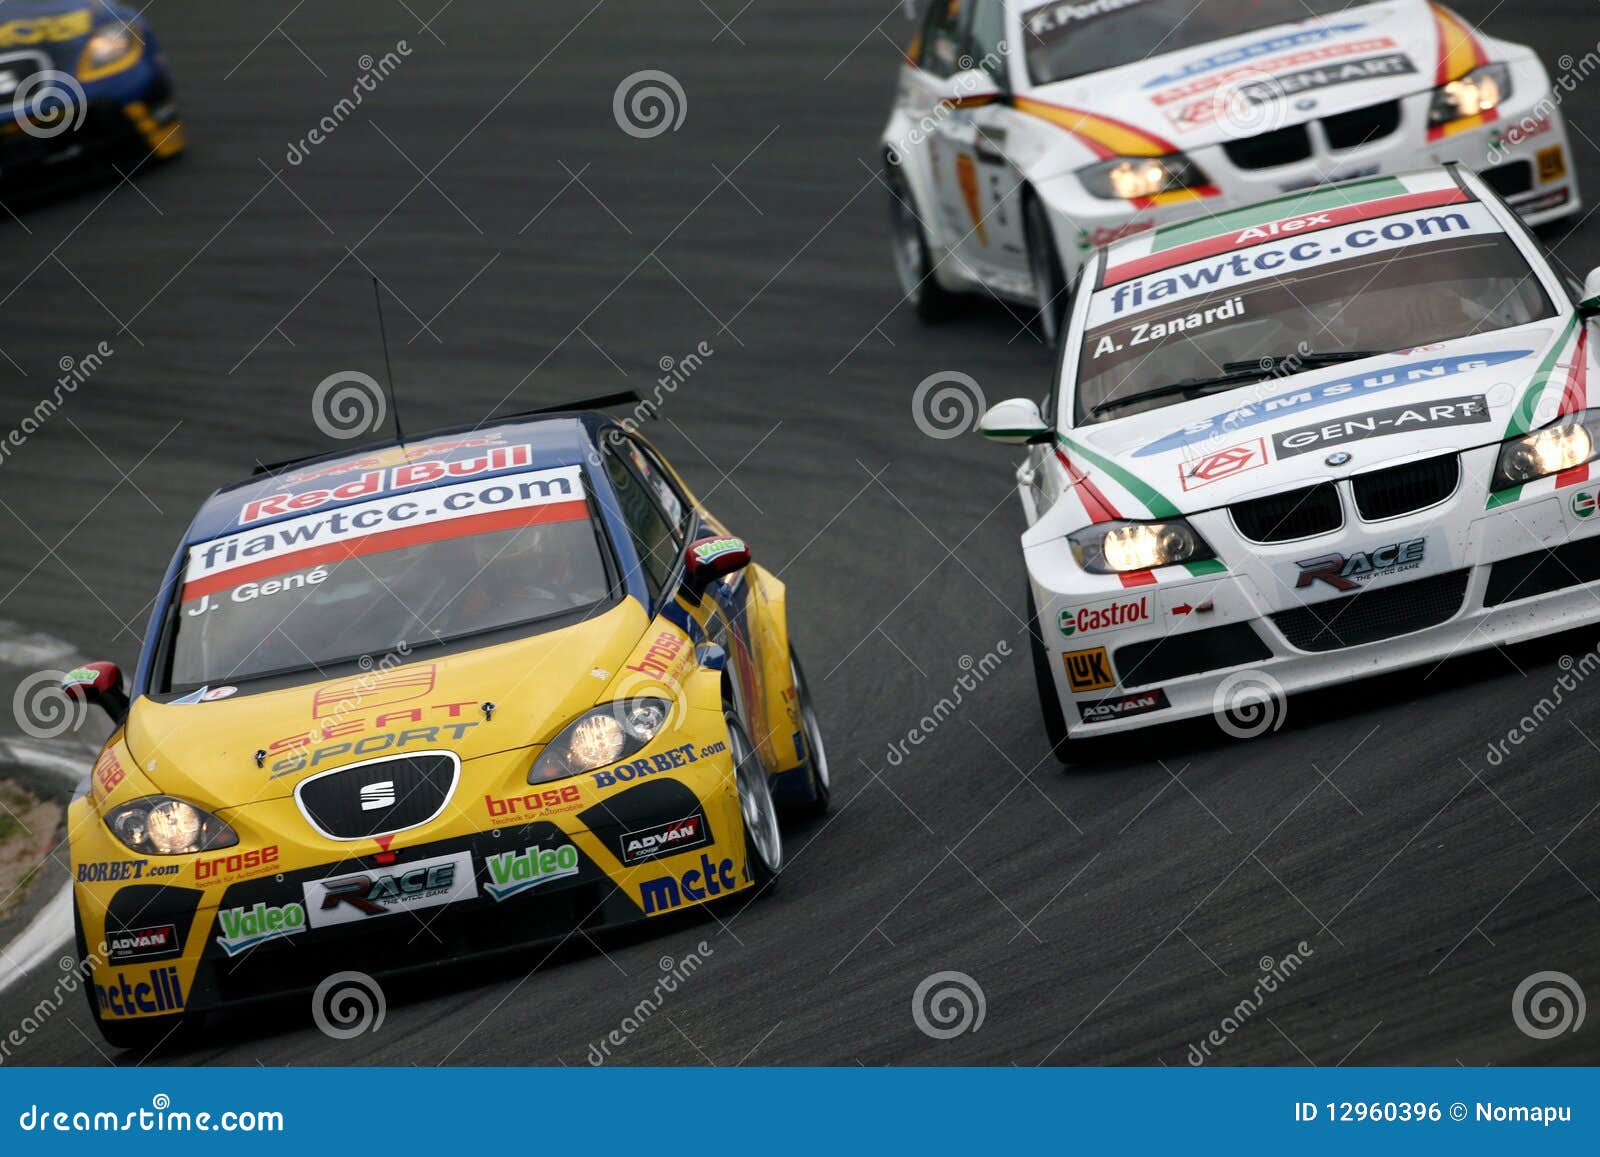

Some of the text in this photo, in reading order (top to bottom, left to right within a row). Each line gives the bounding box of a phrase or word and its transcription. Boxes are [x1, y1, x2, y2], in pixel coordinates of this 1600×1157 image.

[1235, 213, 1332, 244] Alex
[1111, 212, 1470, 314] fiawtcc.com
[1092, 297, 1246, 359] A. Zanardi
[1183, 360, 1488, 435] SAMSUNG
[1282, 401, 1477, 449] GEN-ART
[238, 444, 533, 526] Red Bull
[202, 476, 572, 569] fiawtcc.com
[1295, 537, 1425, 592] RACE
[188, 565, 329, 617] J. Gené
[1077, 596, 1149, 632] Castrol
[626, 632, 685, 681] brose
[269, 701, 479, 758] SEAT
[1083, 697, 1155, 717] ADVAN
[270, 721, 480, 780] SPORT
[591, 741, 727, 788] BORBET.com
[485, 785, 580, 817] brose
[195, 845, 279, 880] brose
[627, 825, 695, 853] ADVAN
[77, 859, 179, 883] BORBET.com
[320, 862, 456, 916] RACE
[491, 846, 577, 885] Valeo
[112, 934, 165, 949] ADVAN
[220, 903, 303, 940] Valeo
